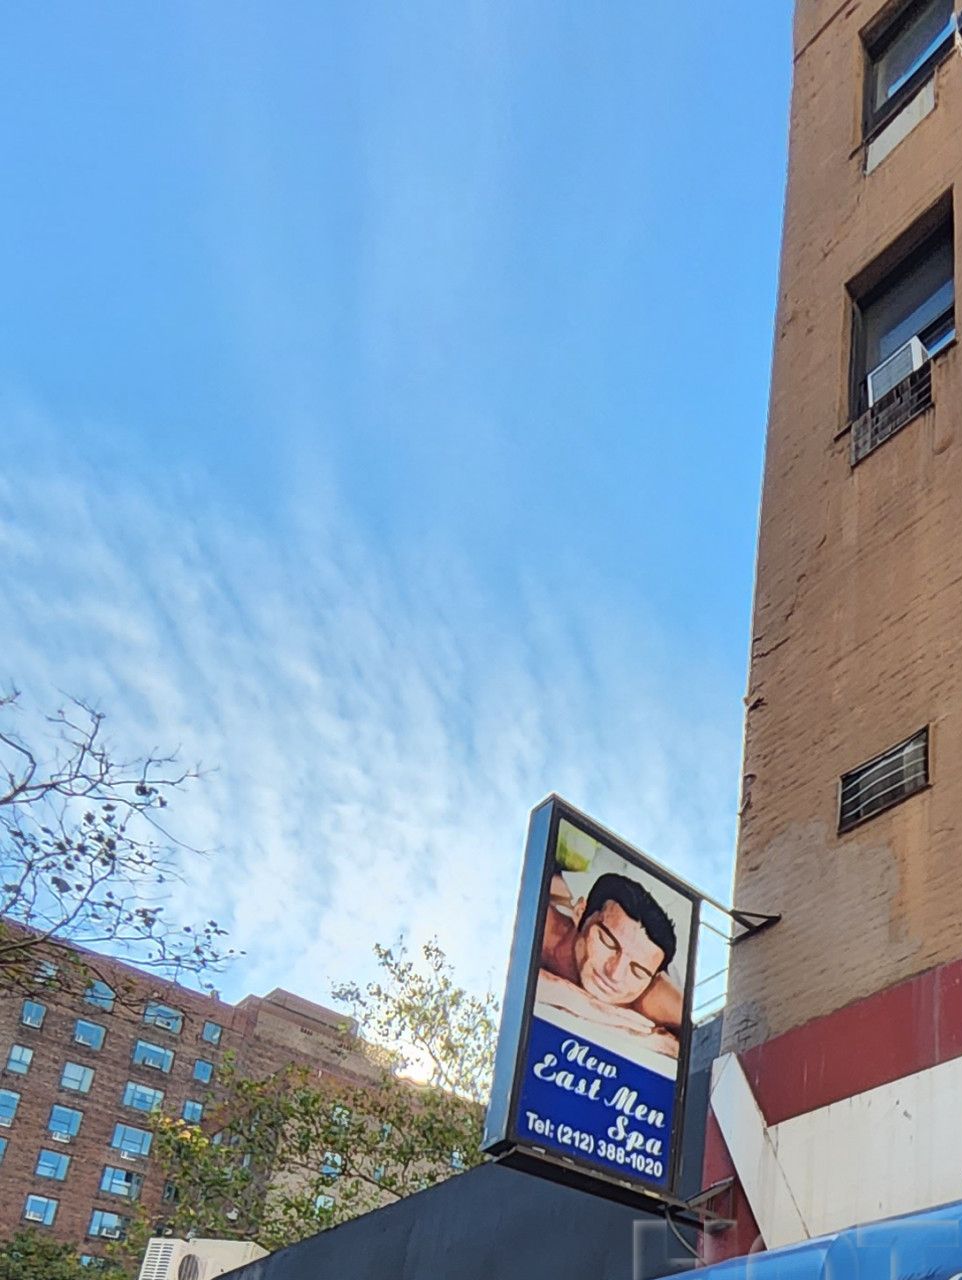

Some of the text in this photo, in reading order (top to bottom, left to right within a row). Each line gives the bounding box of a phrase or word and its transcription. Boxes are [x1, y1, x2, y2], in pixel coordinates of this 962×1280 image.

[561, 1039, 617, 1078] New
[533, 1054, 665, 1128] East Men
[526, 1111, 663, 1177] Tel: (212) 388-1020
[607, 1115, 662, 1156] Spa
